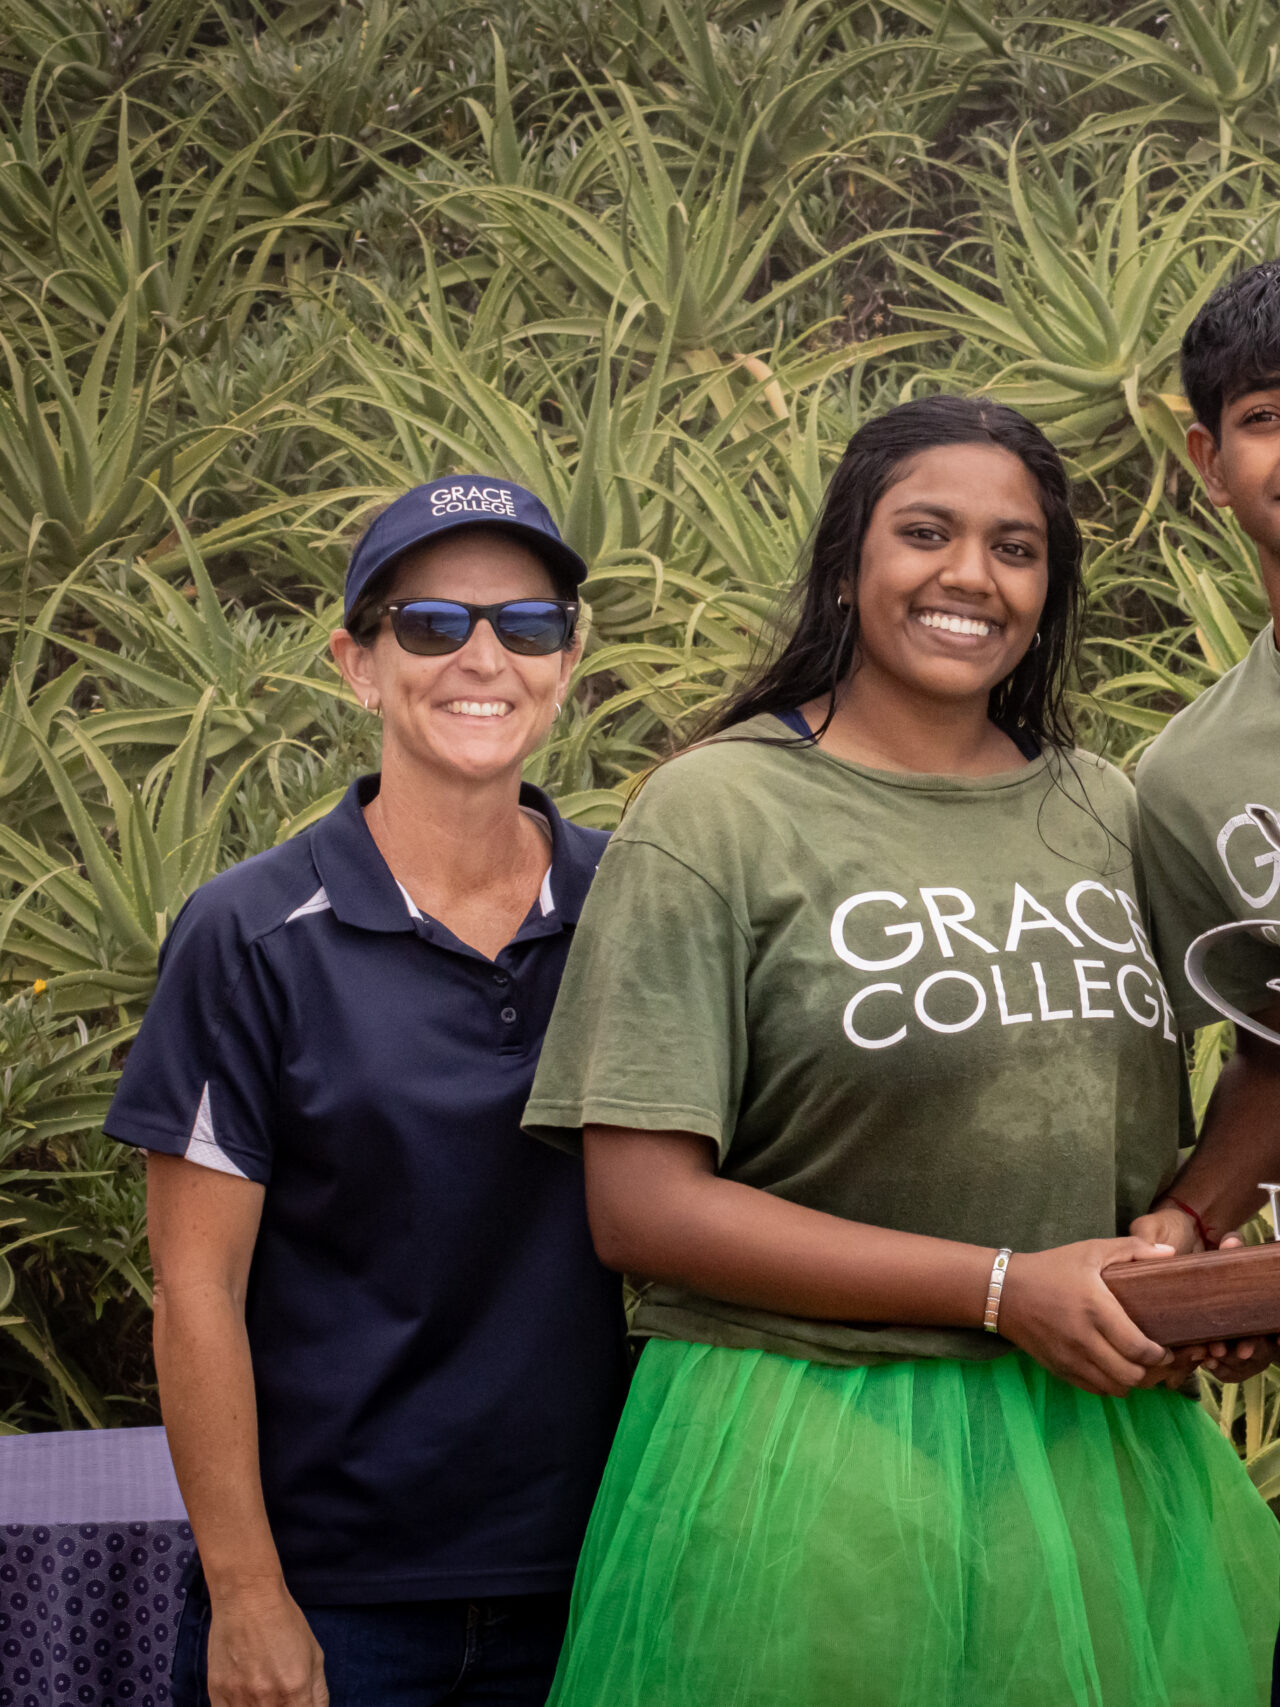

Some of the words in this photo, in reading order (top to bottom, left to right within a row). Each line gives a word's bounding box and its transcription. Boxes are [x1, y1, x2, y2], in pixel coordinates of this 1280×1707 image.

[430, 485, 514, 506] GRACE
[431, 499, 517, 517] COLLEGE
[829, 879, 1159, 972] GRACE
[842, 958, 1178, 1050] COLLEGE
